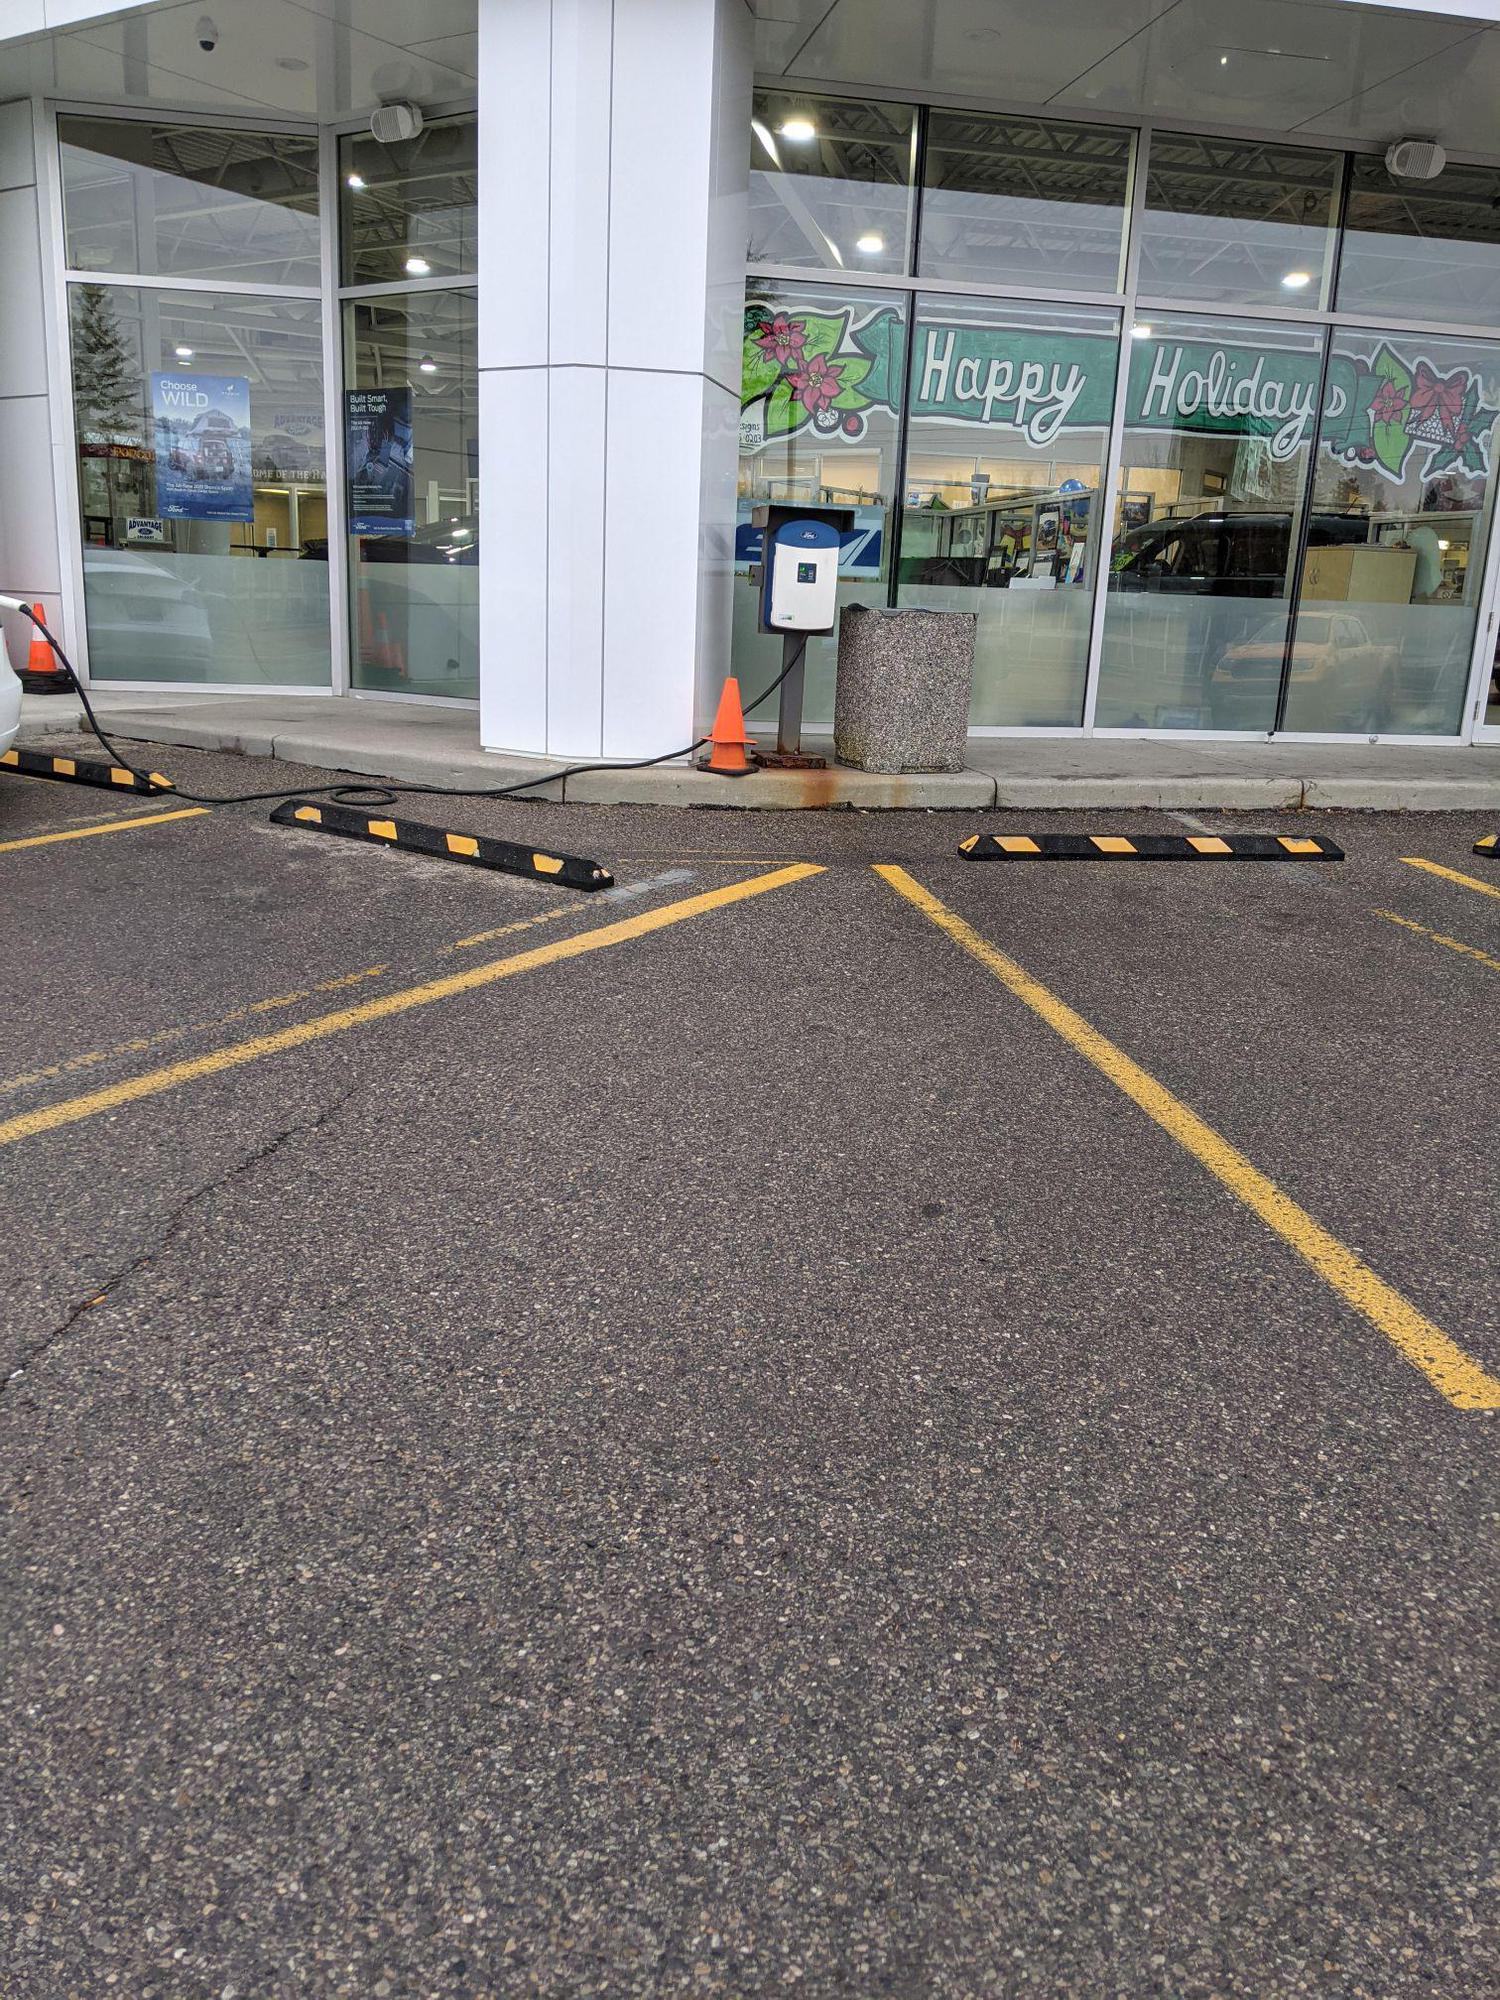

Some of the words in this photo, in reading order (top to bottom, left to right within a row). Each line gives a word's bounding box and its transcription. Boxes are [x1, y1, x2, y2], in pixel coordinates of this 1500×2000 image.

[160, 380, 198, 391] Choose
[161, 391, 209, 407] WILD
[350, 394, 366, 403] Built
[919, 329, 1088, 443] Happy
[1140, 345, 1348, 459] Holidays
[350, 404, 366, 412] Built
[367, 403, 387, 414] Tough
[251, 468, 275, 479] OME
[290, 470, 310, 480] THE
[167, 504, 184, 513] Ford
[128, 519, 163, 533] ADVANTAGE
[801, 530, 817, 540] Ford
